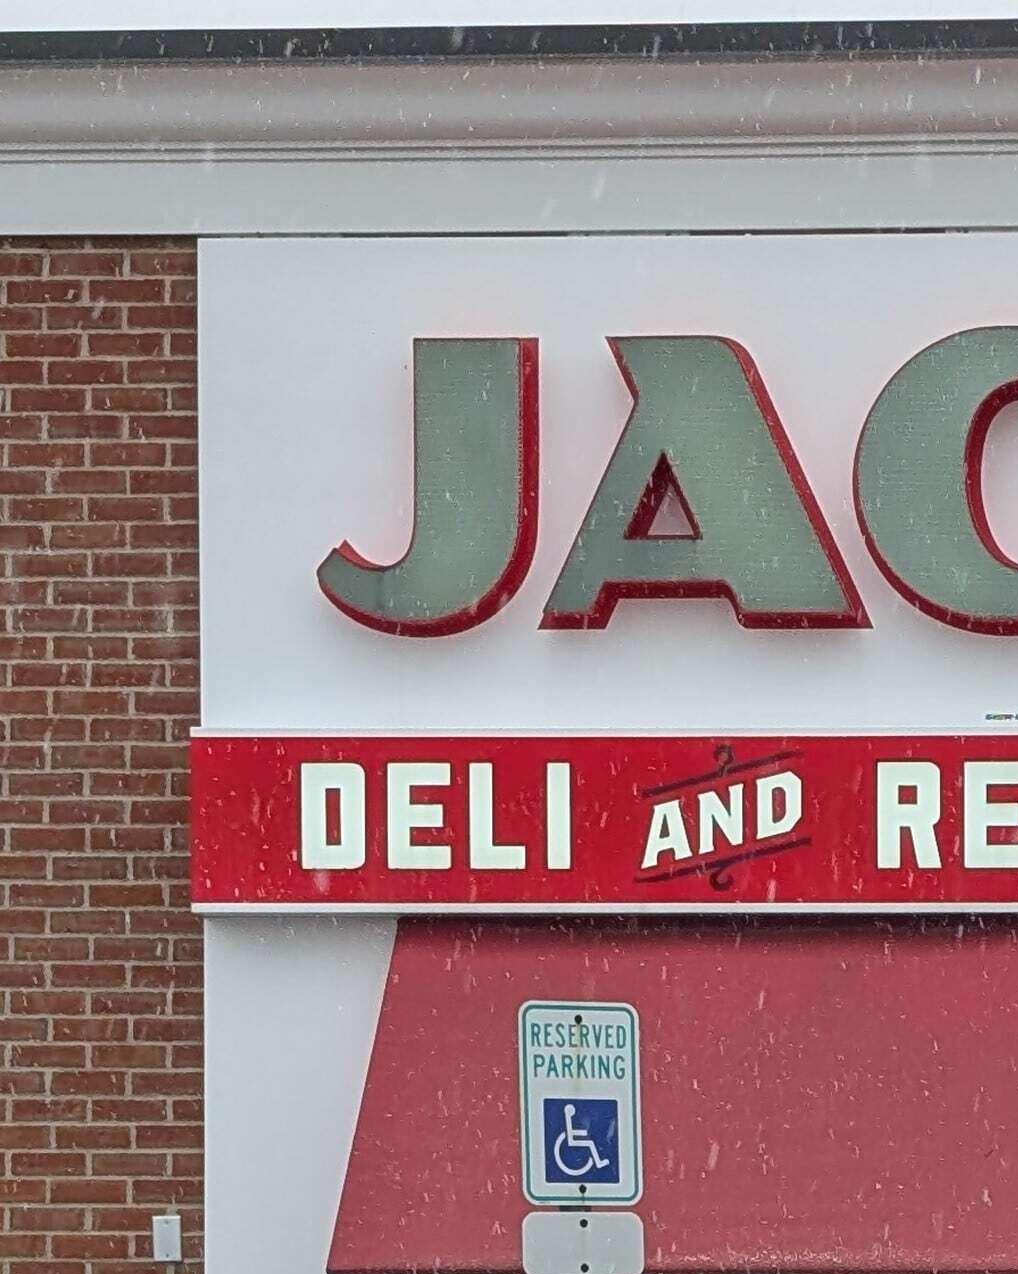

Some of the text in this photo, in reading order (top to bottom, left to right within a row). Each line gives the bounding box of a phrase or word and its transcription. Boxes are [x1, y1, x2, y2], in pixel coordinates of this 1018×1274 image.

[300, 761, 571, 870] DELI
[641, 770, 802, 869] AND
[530, 1023, 627, 1049] RESERVED
[533, 1053, 626, 1080] PARKING
